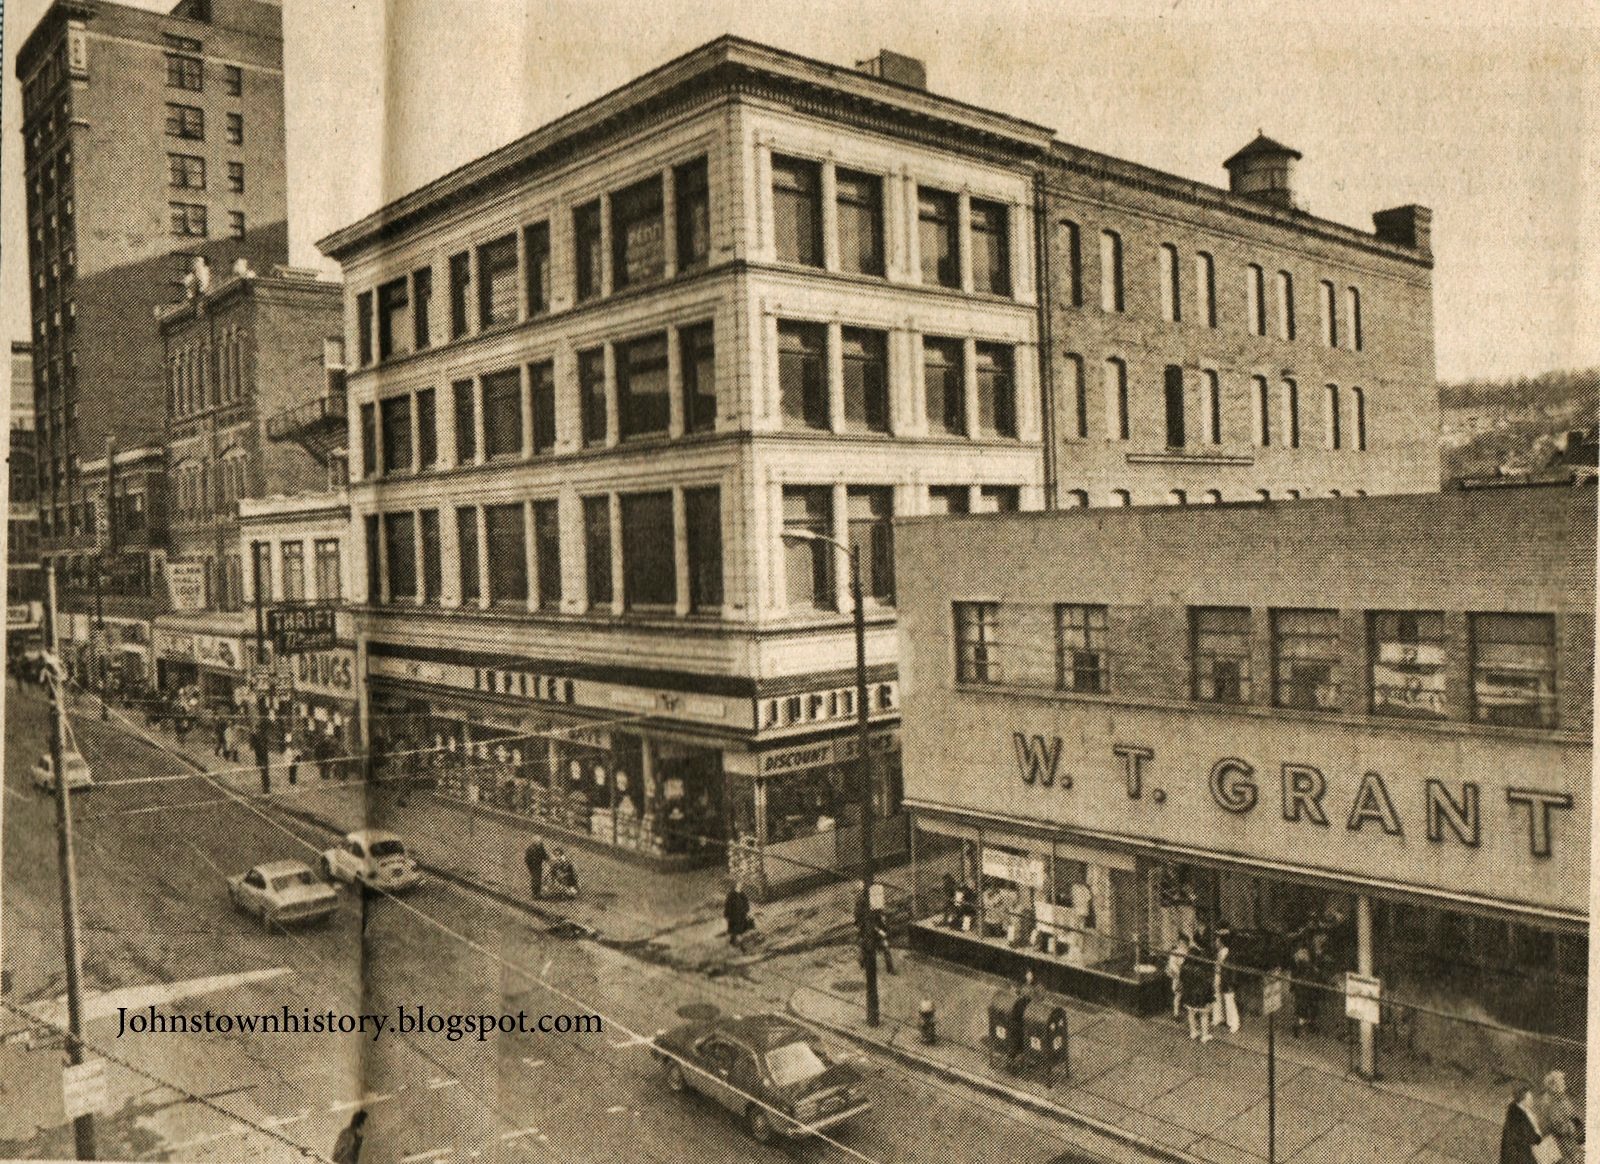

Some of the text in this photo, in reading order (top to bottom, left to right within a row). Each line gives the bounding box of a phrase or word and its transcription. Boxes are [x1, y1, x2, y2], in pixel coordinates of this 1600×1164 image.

[273, 609, 332, 630] THRIFT
[297, 651, 352, 691] DRUGS
[763, 684, 892, 728] JUPITR
[764, 746, 831, 771] DISCOUNT
[1012, 731, 1575, 858] W. T. GRANT
